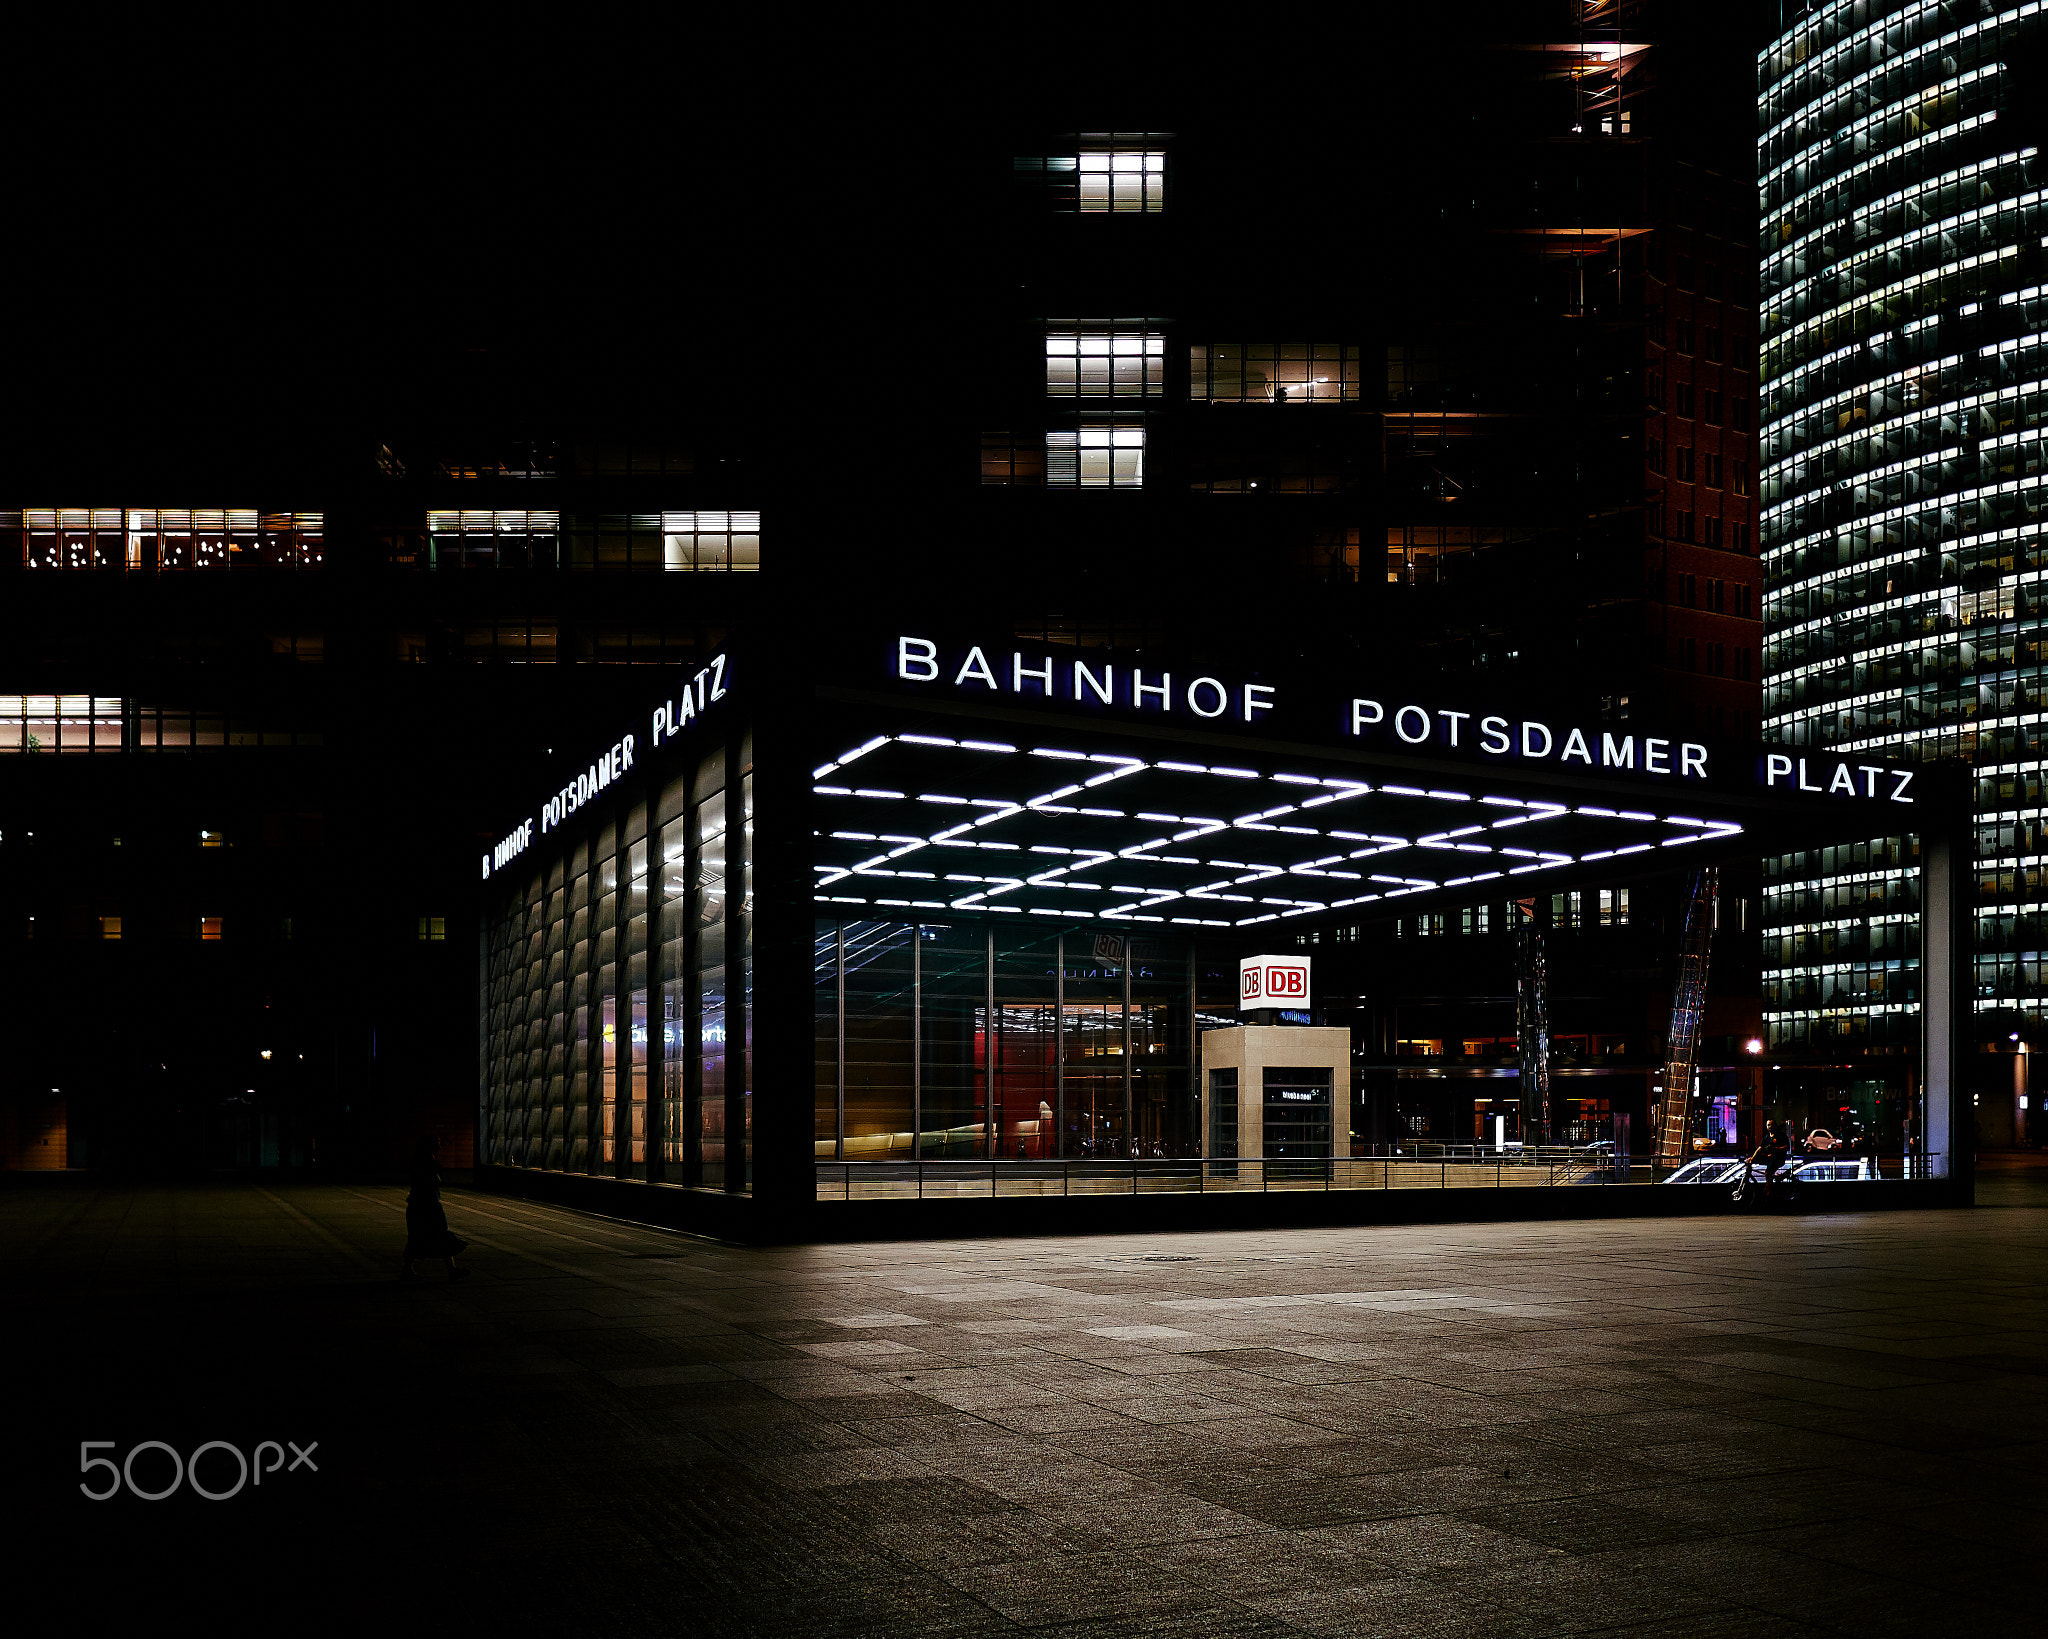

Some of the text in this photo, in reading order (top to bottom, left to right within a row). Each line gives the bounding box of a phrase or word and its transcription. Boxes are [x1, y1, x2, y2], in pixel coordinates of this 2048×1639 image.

[482, 653, 727, 880] BHNHOF POTSDAMER PLATZ
[899, 636, 1915, 803] BAHNHOF POTSDAMER PLATZ
[1244, 971, 1260, 995] DB
[1271, 970, 1303, 993] DB
